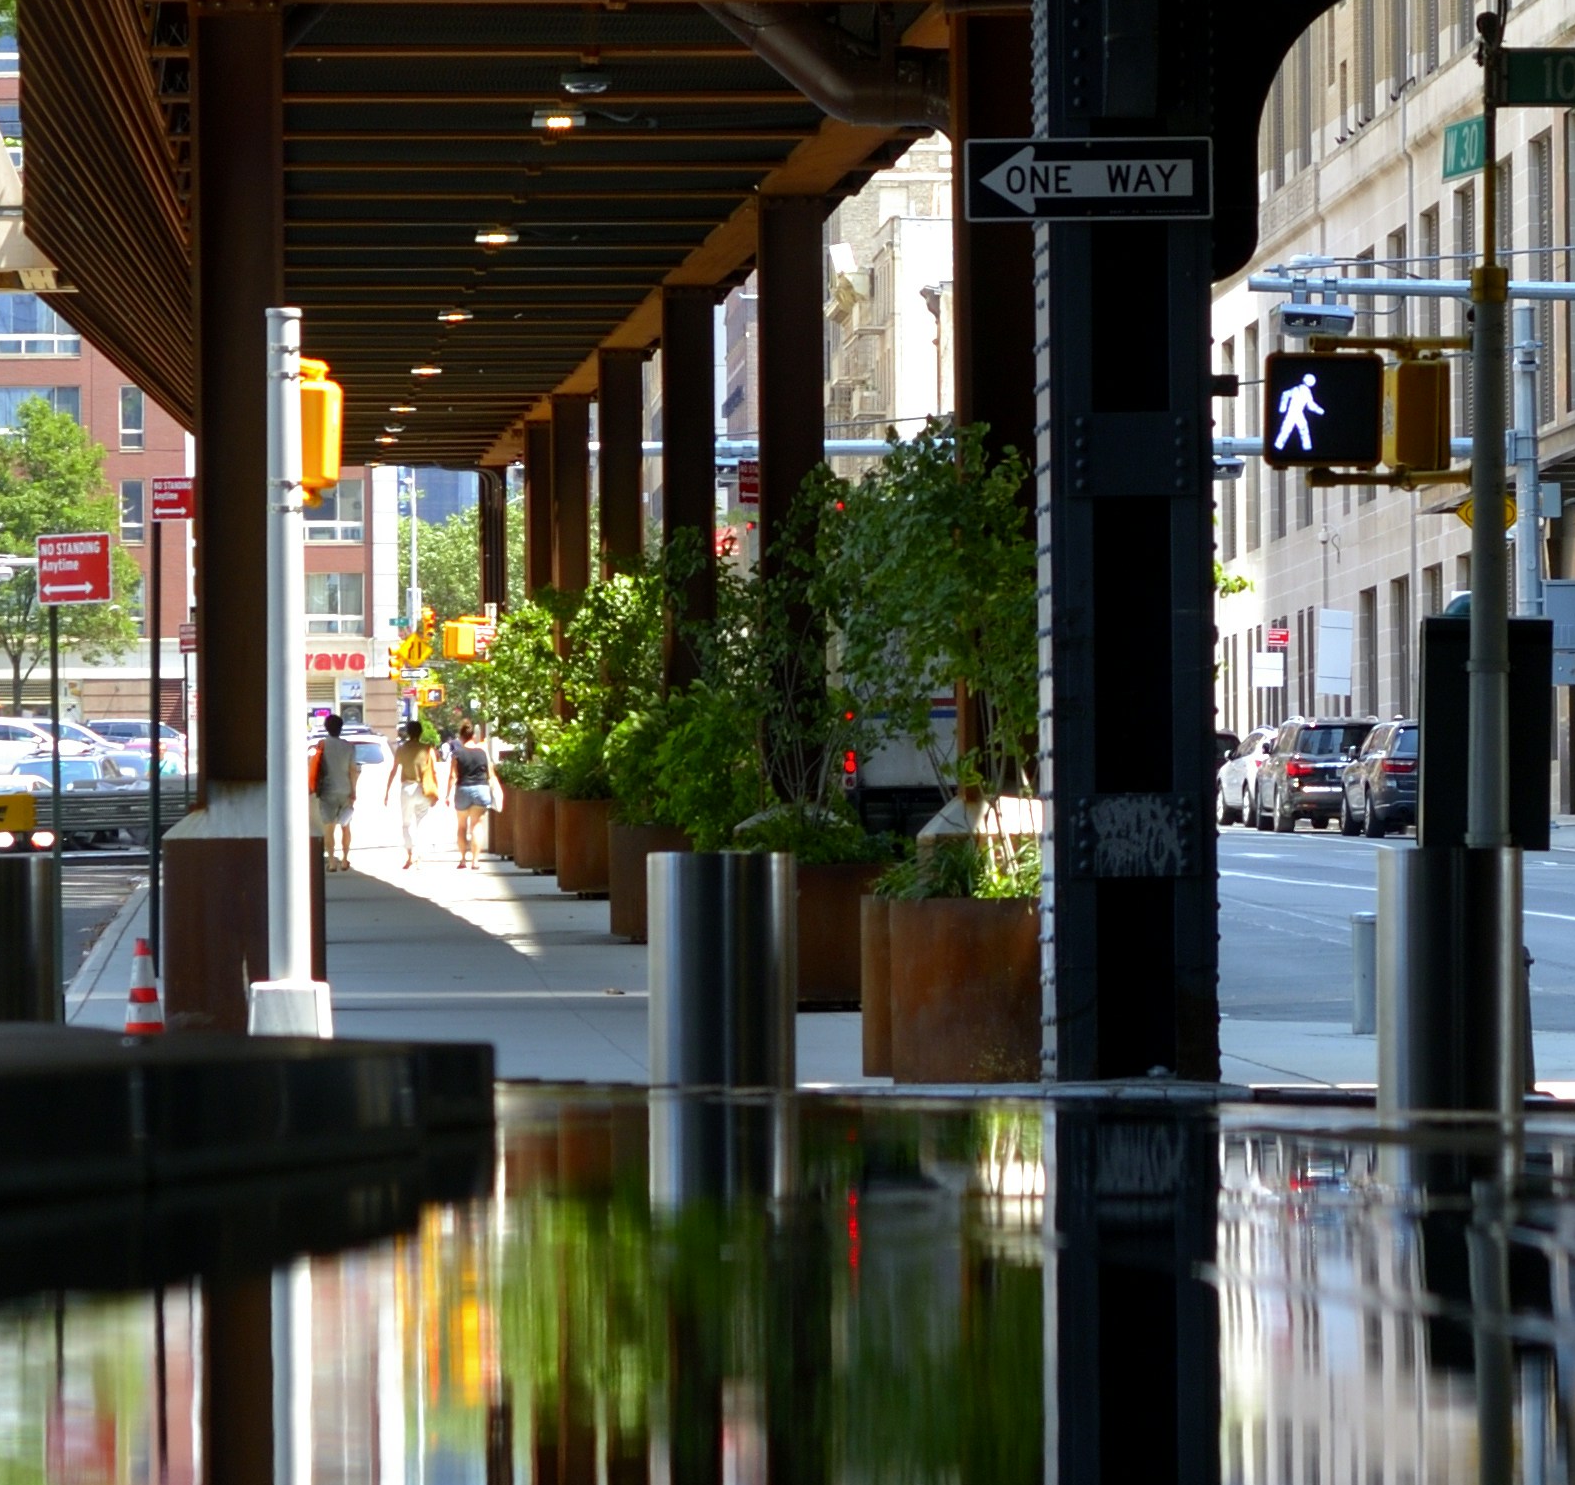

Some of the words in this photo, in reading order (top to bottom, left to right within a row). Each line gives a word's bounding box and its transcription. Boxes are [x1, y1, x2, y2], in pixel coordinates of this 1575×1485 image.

[1446, 131, 1456, 172] W
[1460, 124, 1479, 168] 30
[1006, 165, 1072, 194] ONE
[1106, 164, 1178, 193] WAY
[154, 481, 162, 490] NO
[41, 543, 54, 556] NO
[56, 541, 101, 555] STANDING
[42, 559, 79, 573] Anytime
[305, 652, 365, 671] ravo
